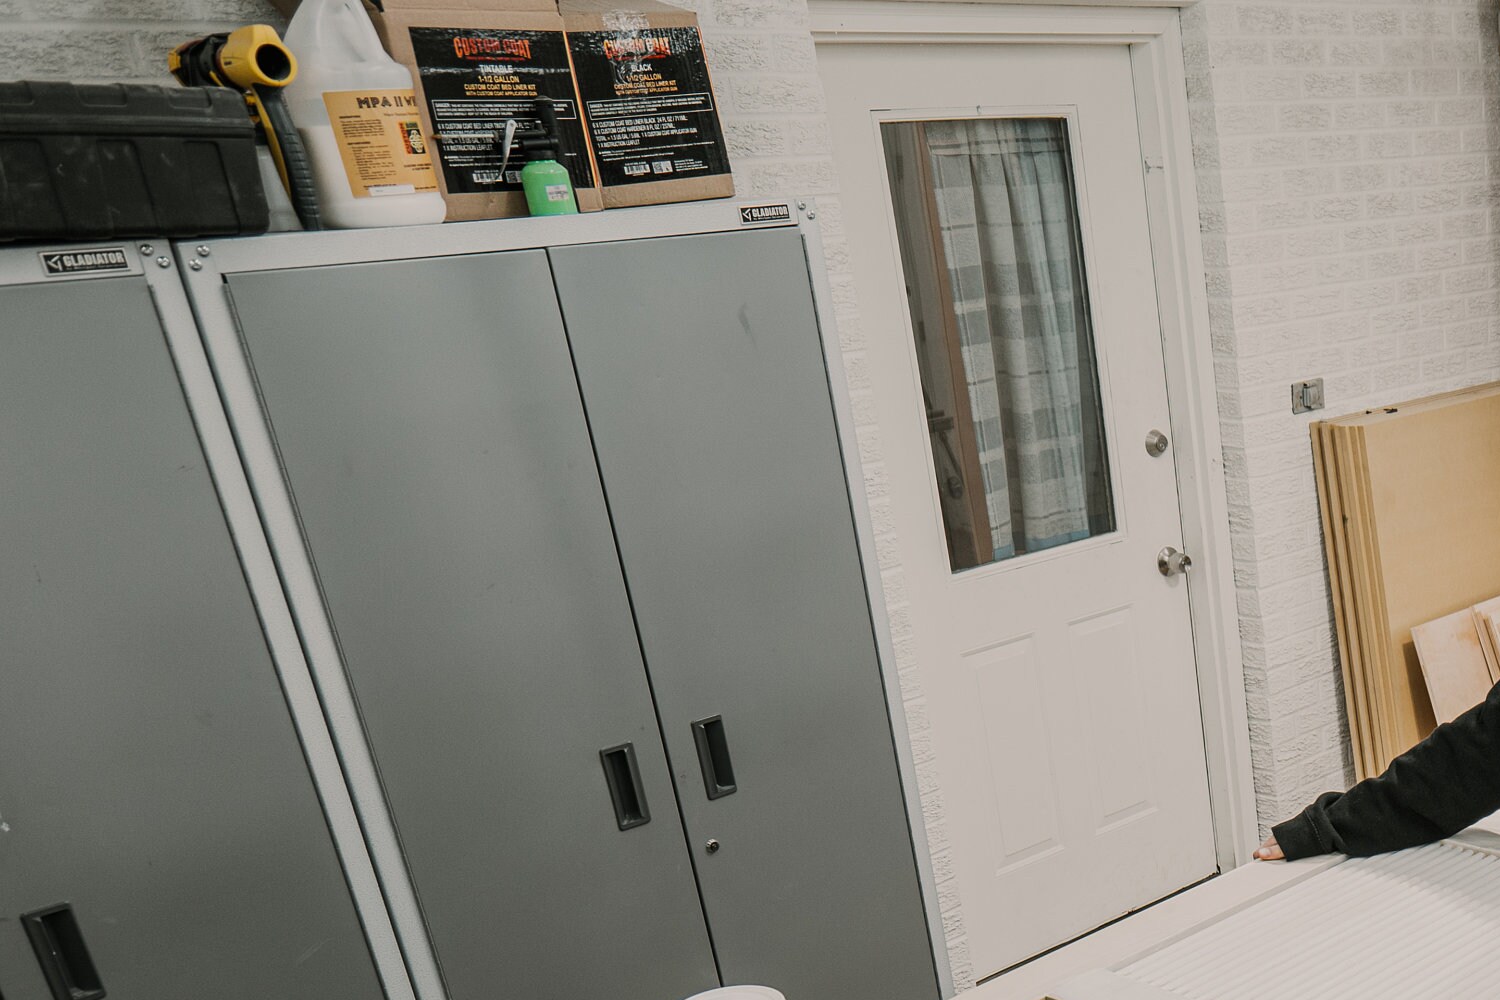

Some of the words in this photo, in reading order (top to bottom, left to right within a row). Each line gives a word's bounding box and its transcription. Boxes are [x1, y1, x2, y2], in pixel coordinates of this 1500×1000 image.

[503, 39, 531, 59] COAT
[479, 64, 513, 73] TINTABLE
[630, 64, 653, 72] BLACK
[494, 75, 519, 83] GALLON
[639, 73, 662, 81] GALLON
[356, 96, 391, 108] MPA
[752, 206, 789, 217] GLADIATOR
[62, 252, 126, 267] GLADIATOR
